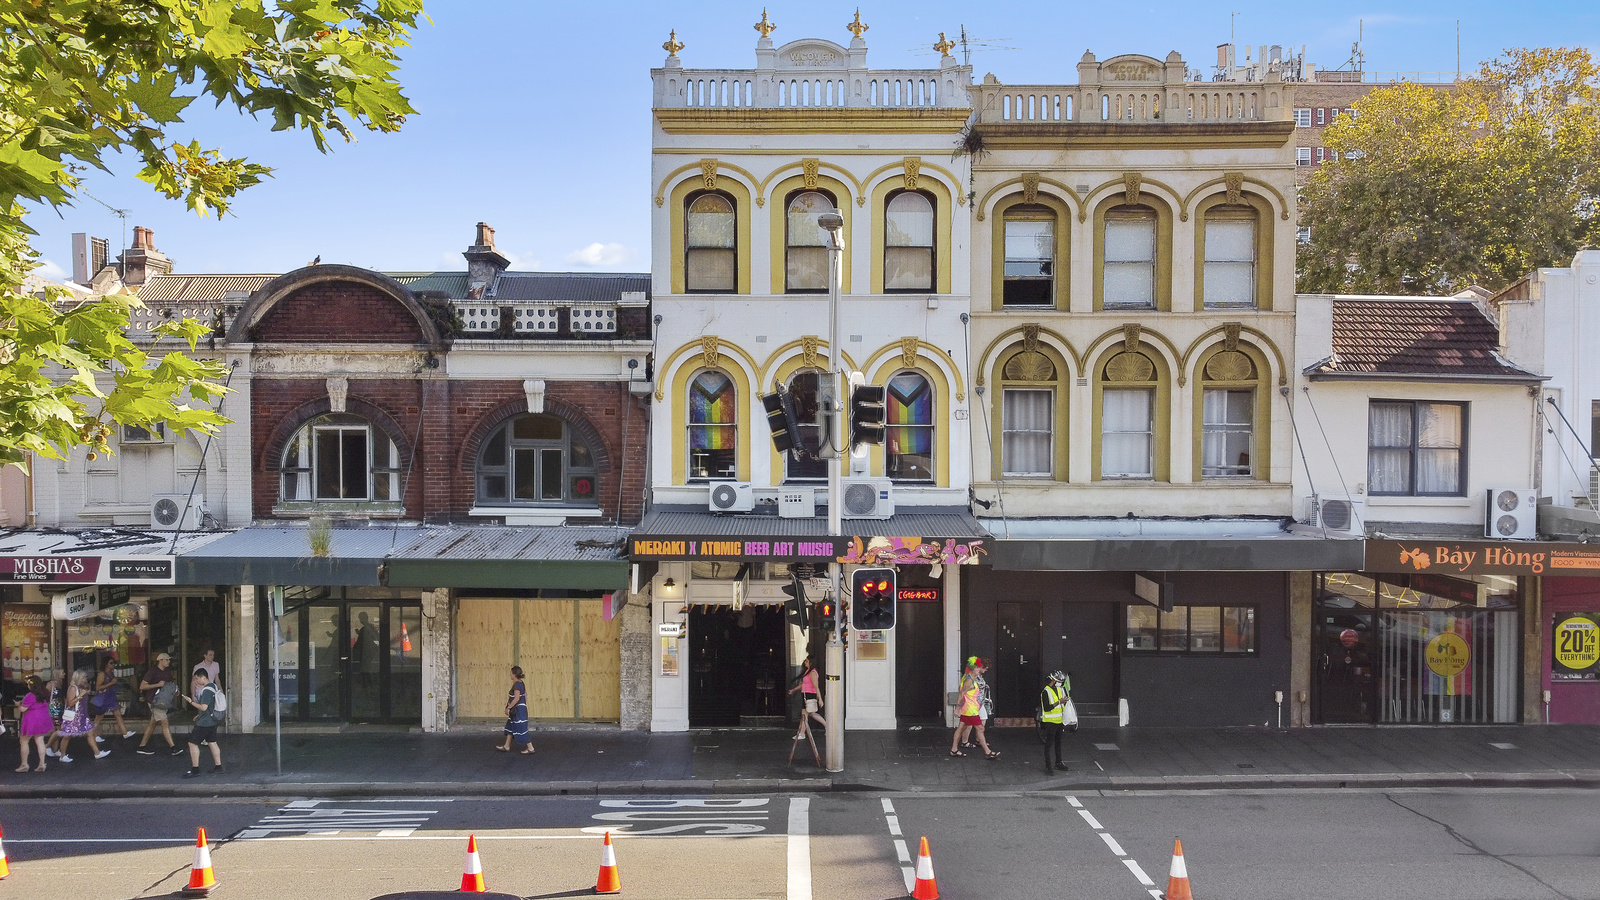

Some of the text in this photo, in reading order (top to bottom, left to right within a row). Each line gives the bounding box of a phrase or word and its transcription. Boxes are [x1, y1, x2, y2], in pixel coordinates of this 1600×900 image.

[634, 540, 834, 557] MERAKI X ATOMIC BEER ART MUSIC
[13, 557, 84, 574] MISHA'S
[1435, 545, 1546, 574] Bảy Hồng
[66, 592, 88, 605] BOTTLE
[69, 603, 86, 614] SHOP
[1584, 645, 1595, 653] OFF
[1560, 653, 1596, 661] EVERYTHING
[580, 798, 770, 835] BUS
